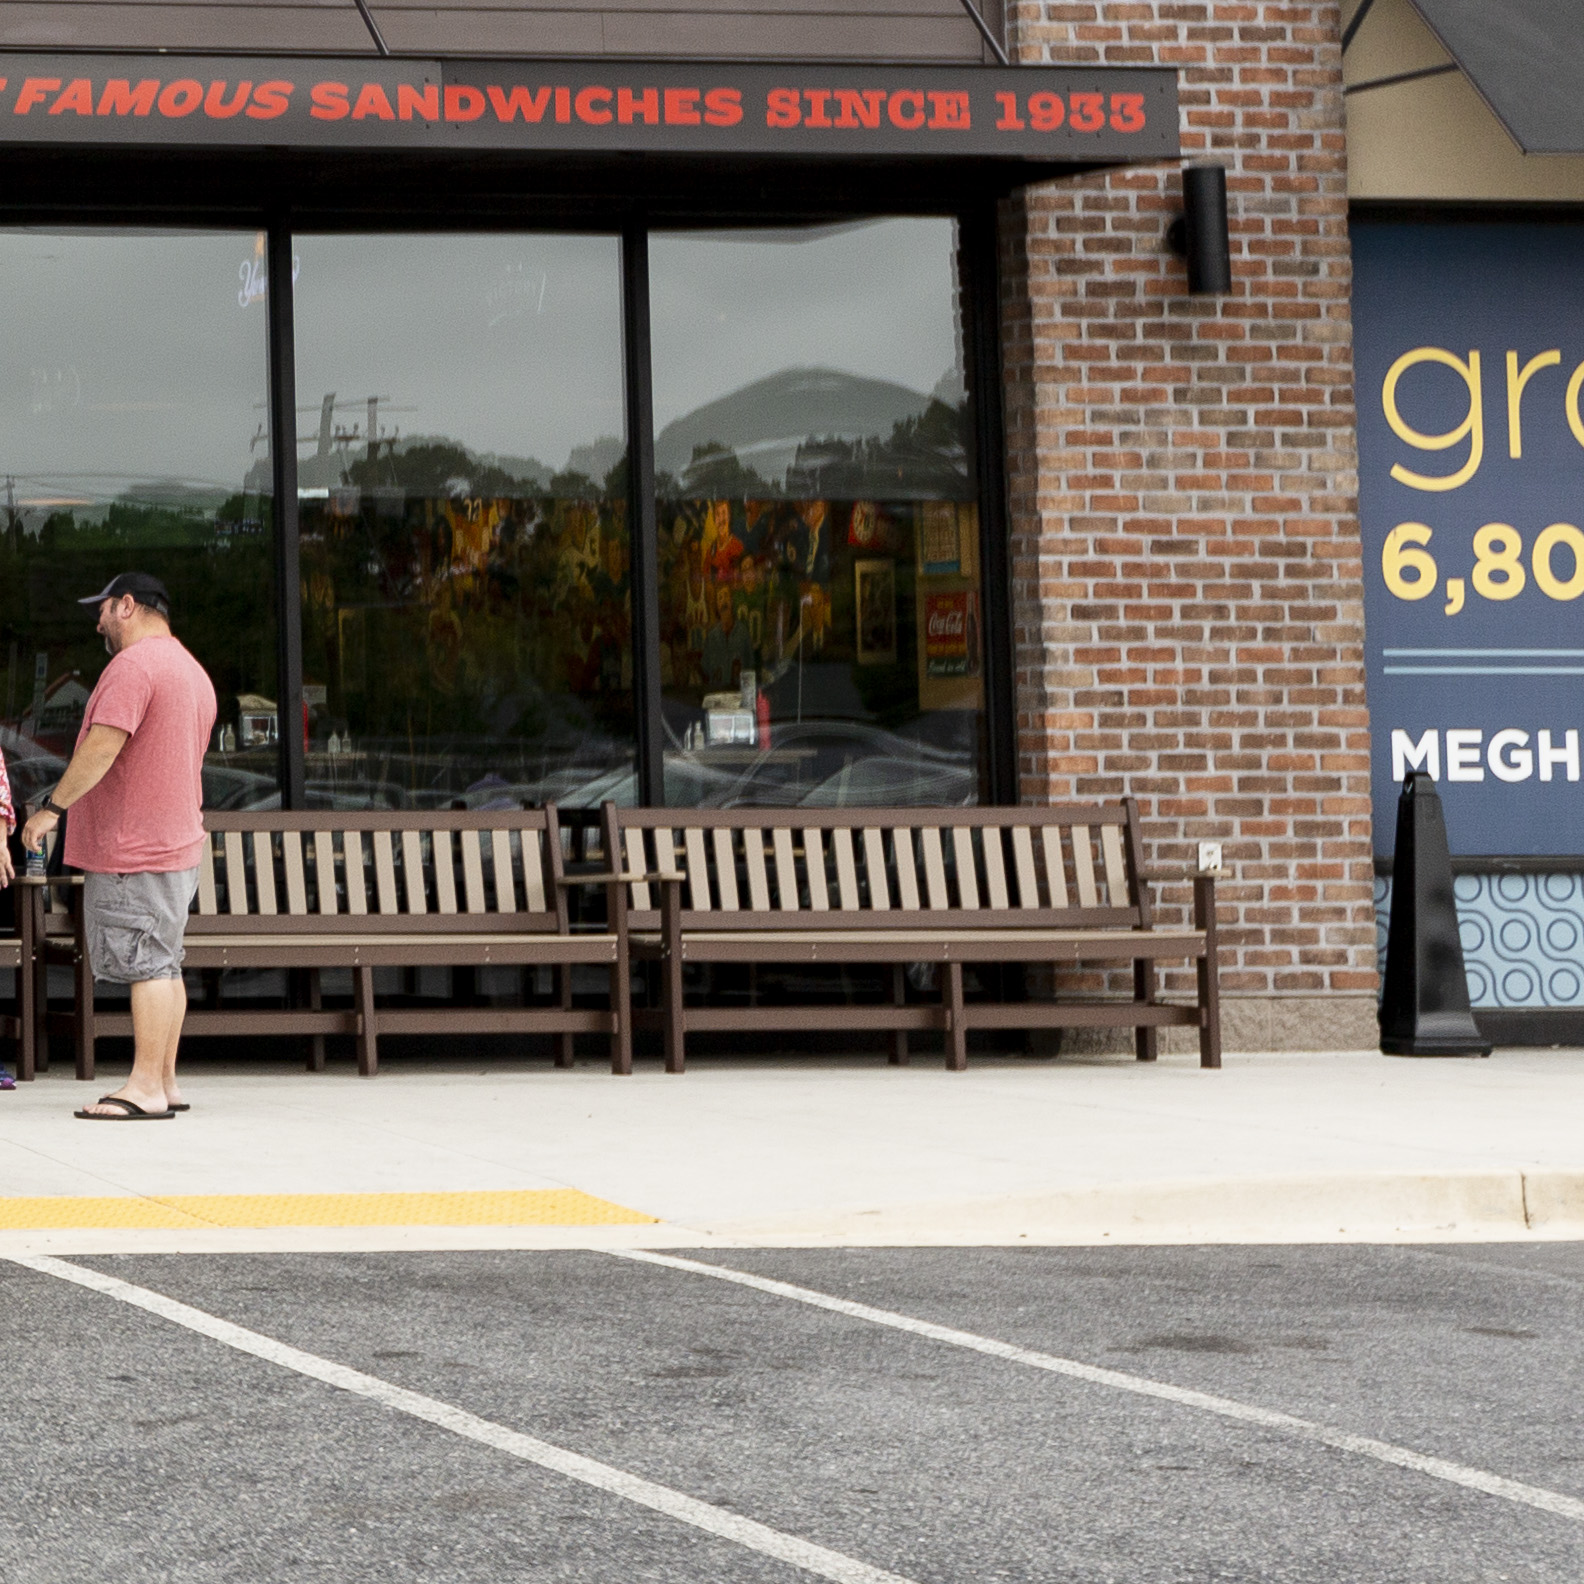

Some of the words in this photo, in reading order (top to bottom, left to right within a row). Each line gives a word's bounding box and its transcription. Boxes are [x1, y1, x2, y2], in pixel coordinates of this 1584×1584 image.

[13, 79, 294, 120] FAMOUS
[309, 82, 743, 127] SANDWICHES
[767, 88, 971, 130] SINCE
[995, 91, 1146, 133] 1933
